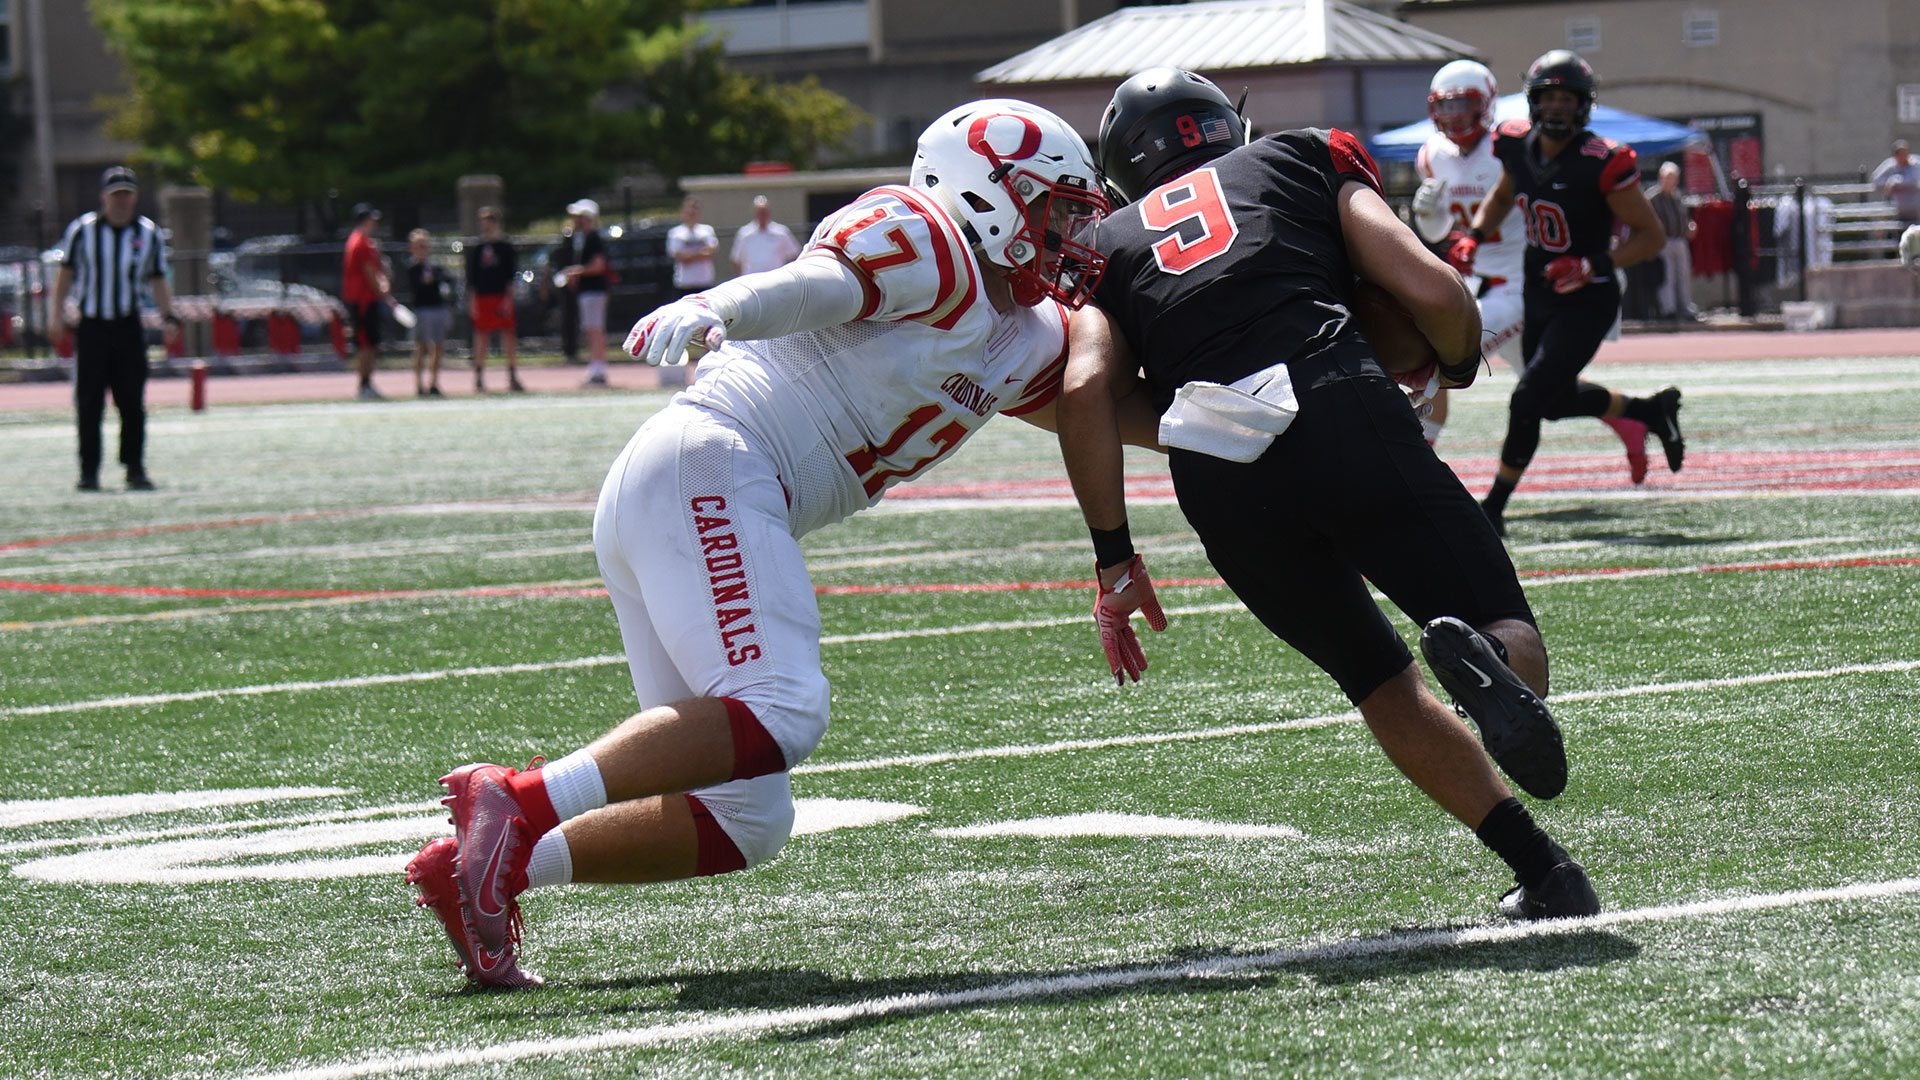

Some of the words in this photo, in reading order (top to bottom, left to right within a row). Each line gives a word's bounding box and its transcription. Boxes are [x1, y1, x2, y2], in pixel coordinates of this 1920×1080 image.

[1176, 115, 1202, 147] 9
[834, 205, 923, 282] 17
[1138, 166, 1240, 276] 9
[1516, 193, 1572, 253] 10
[845, 402, 969, 499] 17
[691, 495, 762, 667] CARDINALS
